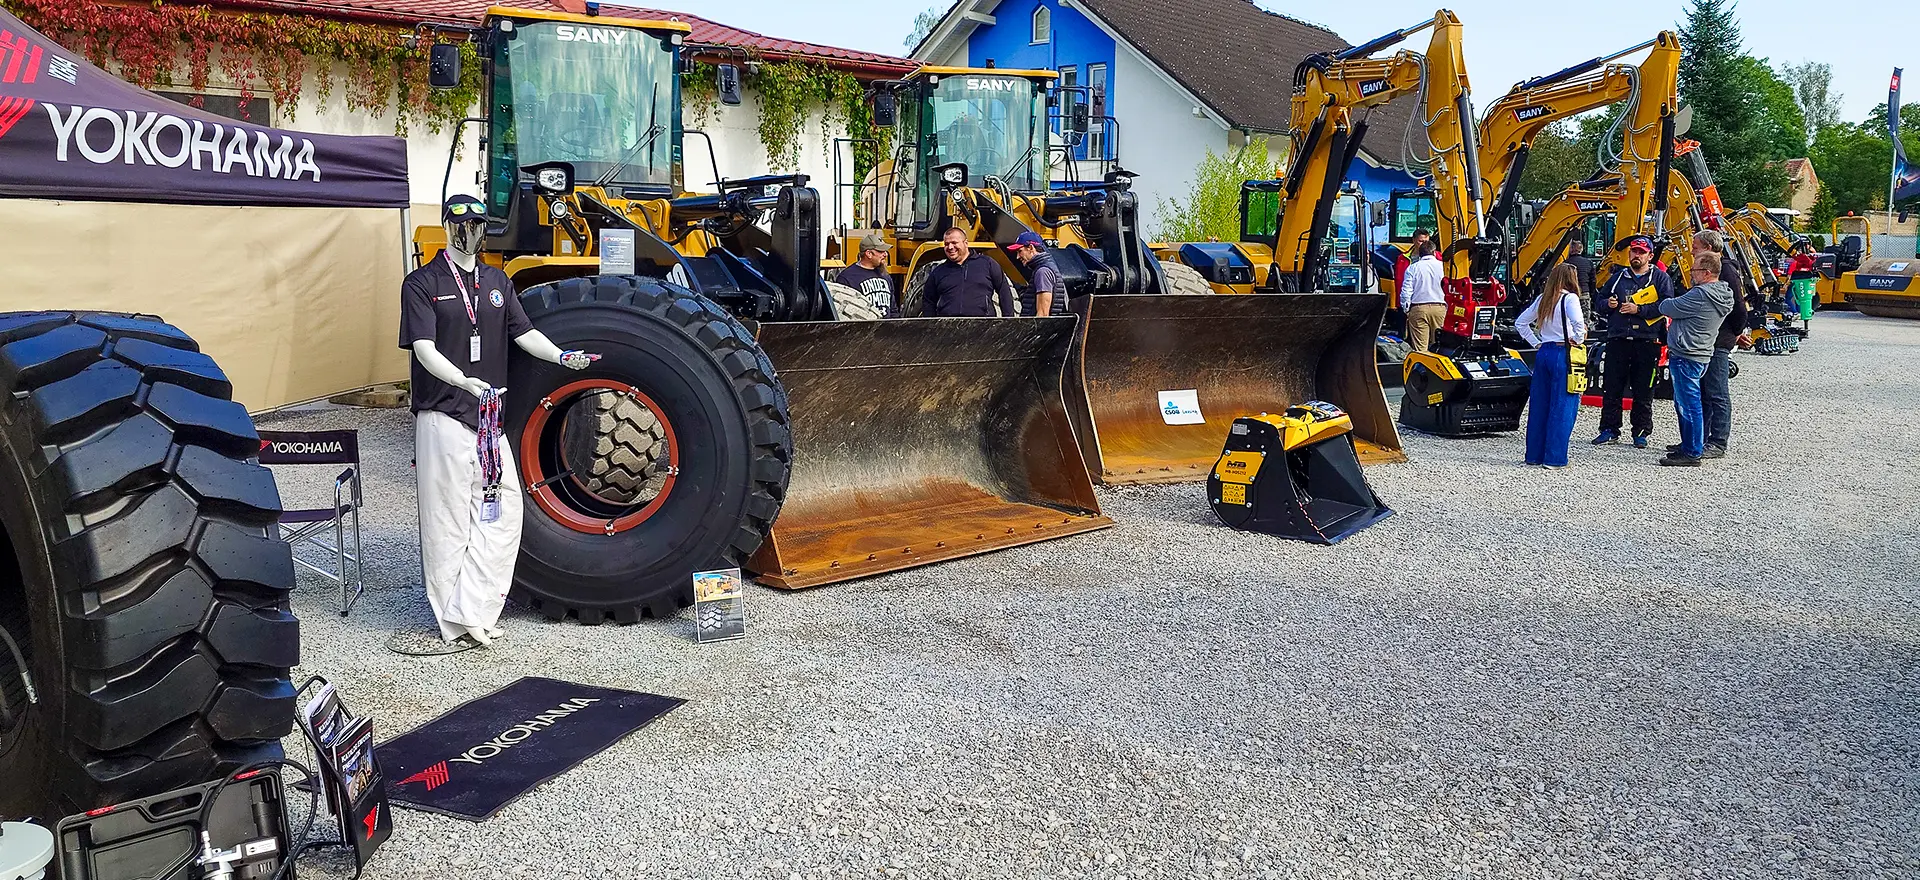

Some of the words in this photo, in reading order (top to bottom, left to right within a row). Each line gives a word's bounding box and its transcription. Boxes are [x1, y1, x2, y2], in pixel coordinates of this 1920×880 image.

[556, 25, 627, 45] SANY
[967, 78, 1015, 92] SANY
[1362, 80, 1384, 94] SANY
[1519, 106, 1544, 120] SANY
[41, 102, 321, 182] YOKOHAMA
[1580, 201, 1605, 210] SANY
[1869, 278, 1895, 287] SANY
[271, 441, 343, 454] YOKOHAMA
[449, 697, 600, 765] YOKOHAMA
